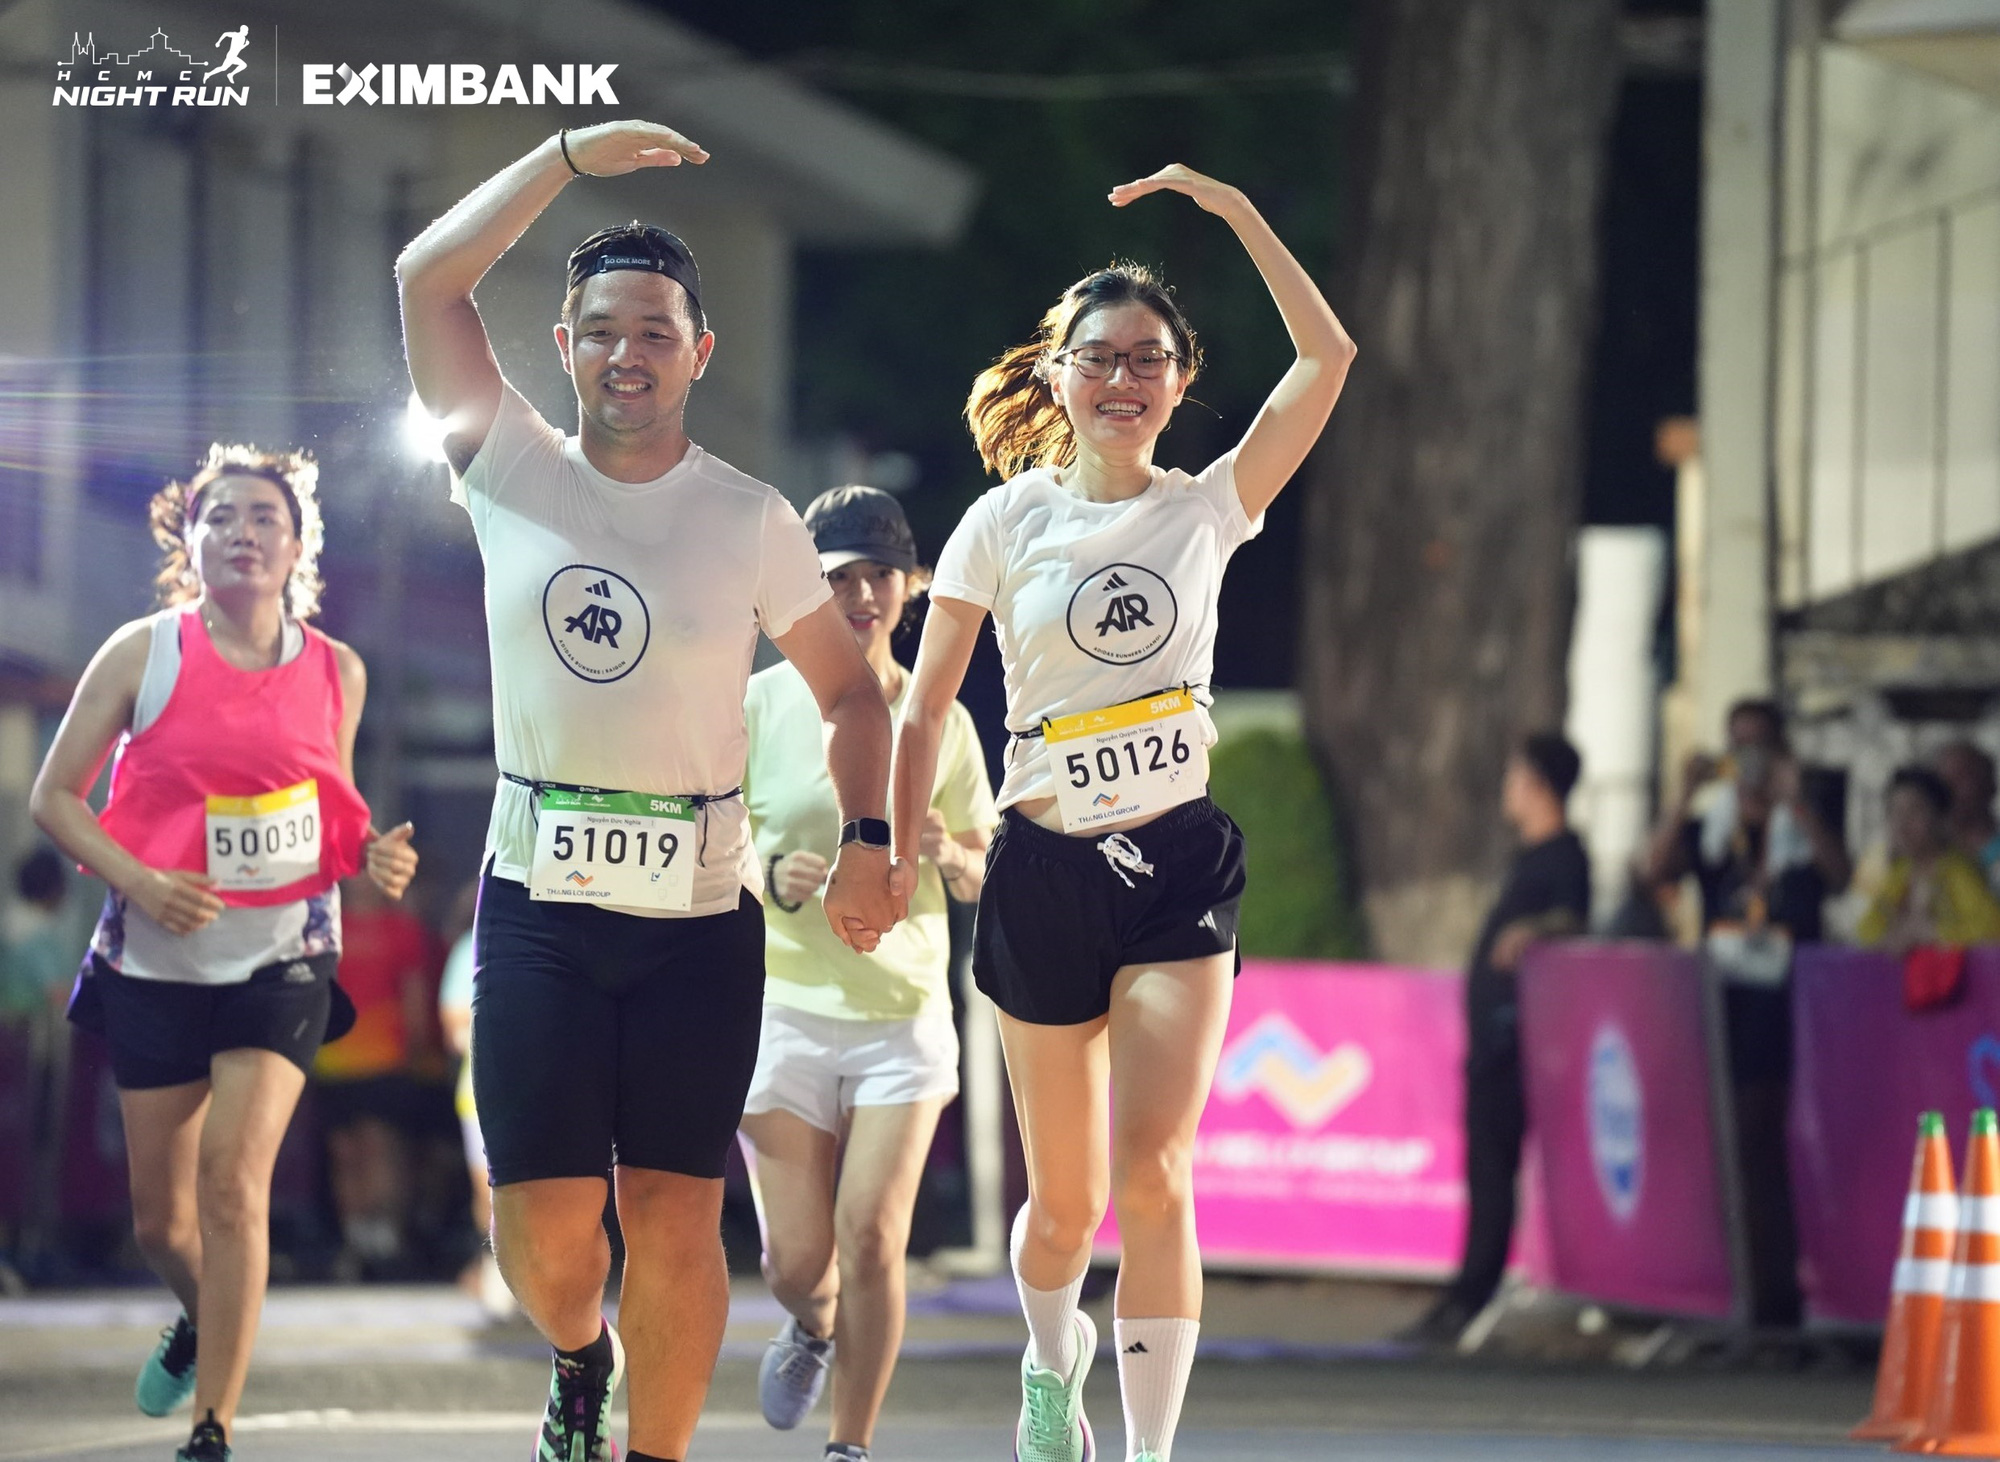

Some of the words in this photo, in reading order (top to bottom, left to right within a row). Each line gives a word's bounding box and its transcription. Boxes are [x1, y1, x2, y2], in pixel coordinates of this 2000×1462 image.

[564, 604, 622, 649] AR
[1095, 594, 1155, 637] AR
[559, 639, 575, 661] ADIDAS
[575, 661, 600, 674] RUNNERS
[605, 660, 626, 673] SAIGON
[1093, 646, 1114, 657] ADIDAS
[1115, 649, 1142, 658] RUNNERS
[1150, 696, 1181, 714] 5KM
[1138, 726, 1155, 734] Trang
[1066, 729, 1190, 789] 50126
[650, 799, 682, 815] 5KM
[1115, 804, 1141, 816] GROUP
[215, 814, 314, 857] 50030
[553, 825, 679, 868] 51019
[585, 890, 612, 898] GROUP
